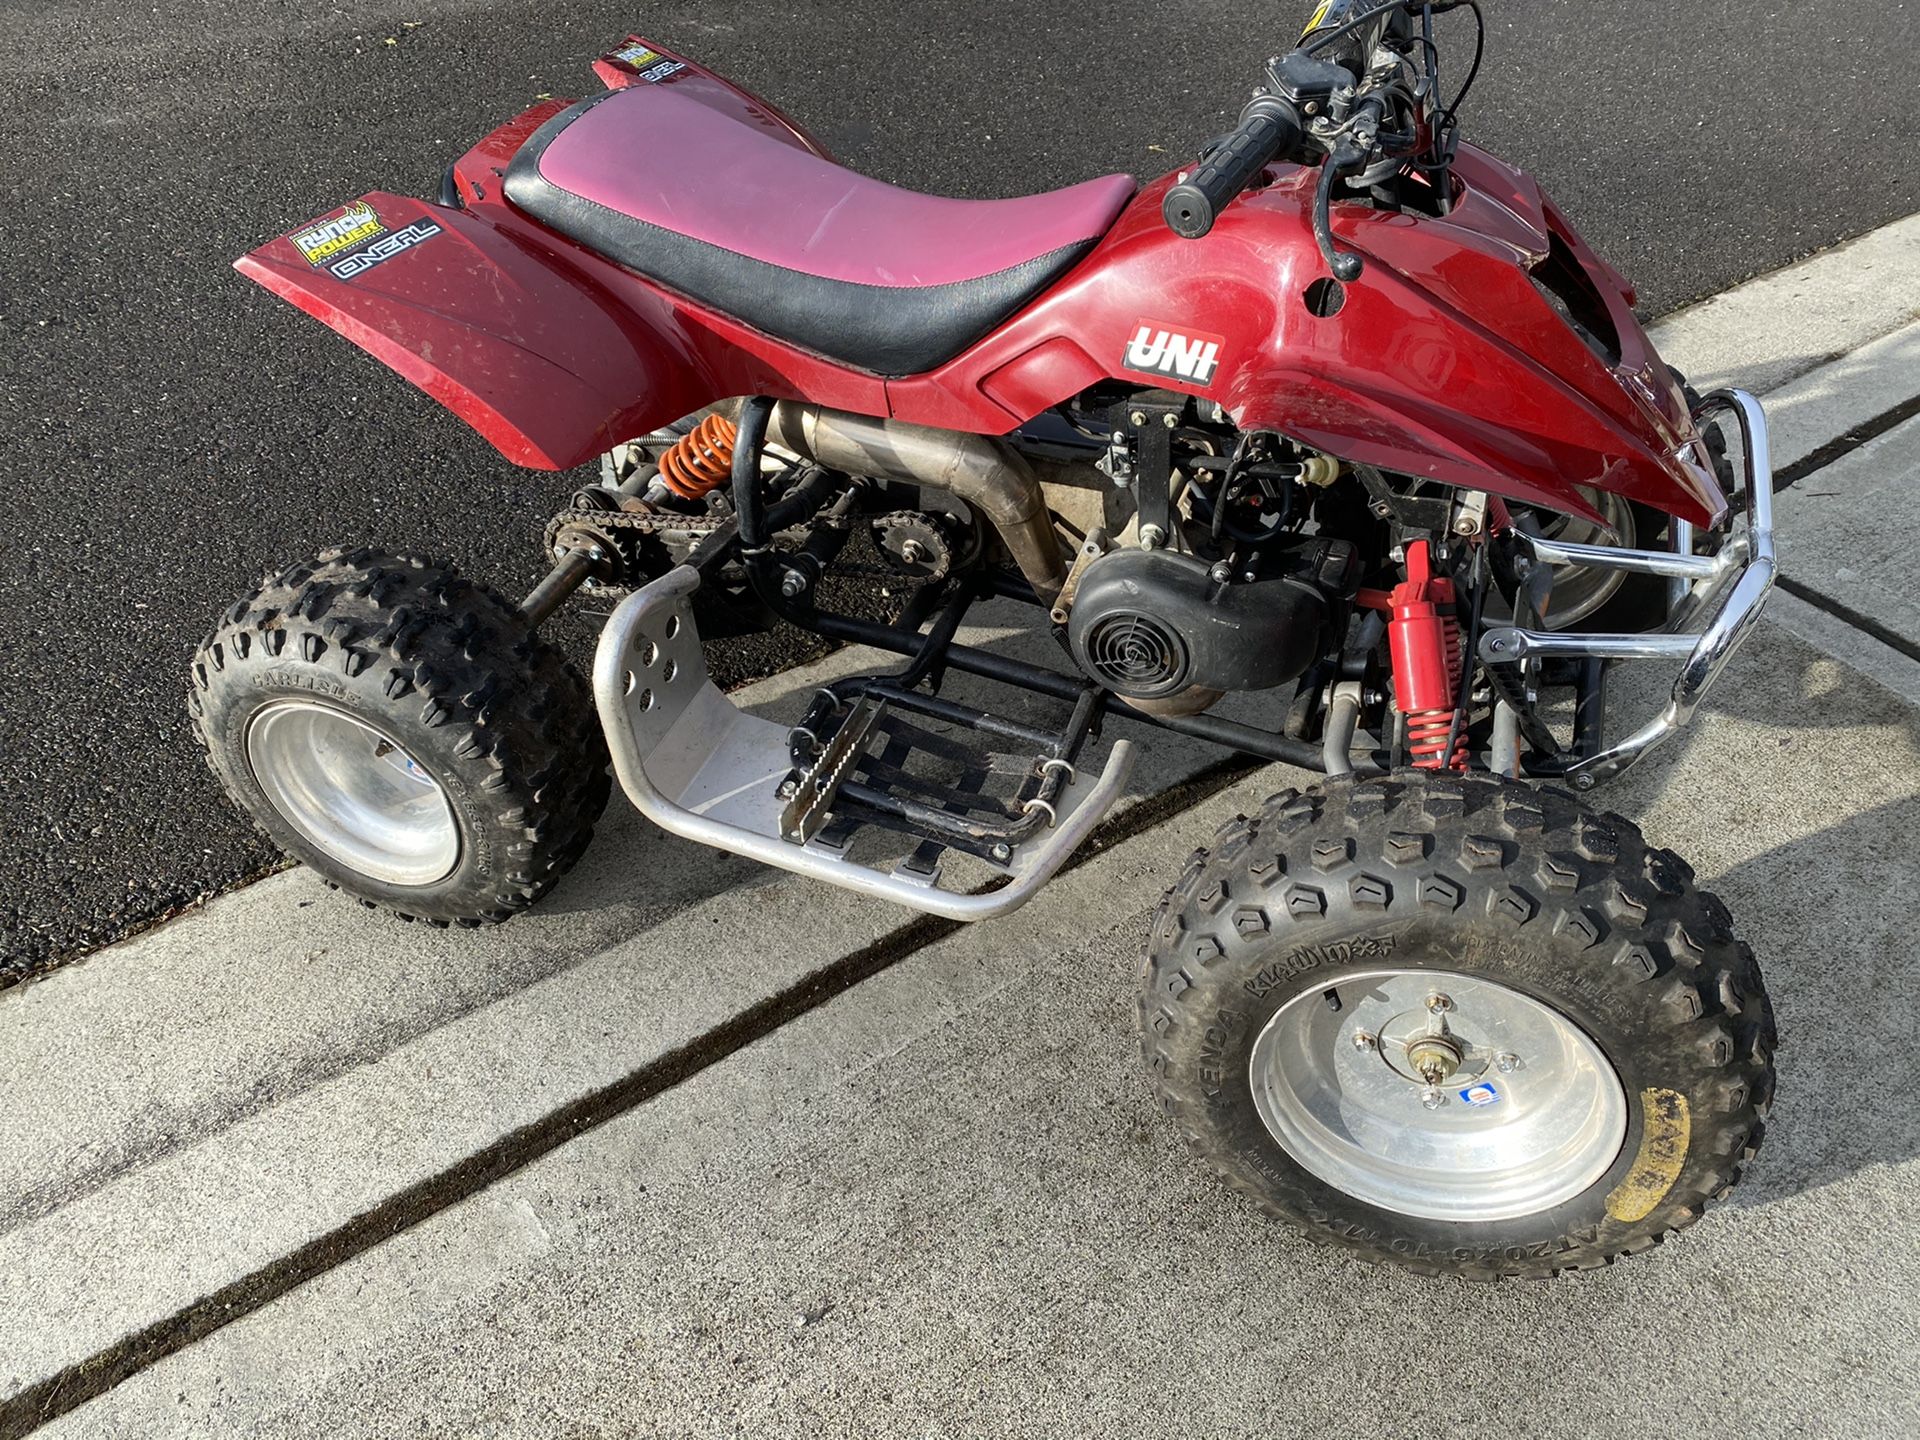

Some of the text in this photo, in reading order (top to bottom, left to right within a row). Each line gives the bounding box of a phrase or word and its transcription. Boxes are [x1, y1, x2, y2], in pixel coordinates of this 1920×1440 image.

[306, 221, 381, 261] POWER
[1127, 326, 1219, 381] UNI
[252, 671, 362, 707] CARLISLE
[1200, 1006, 1247, 1099] KENDA
